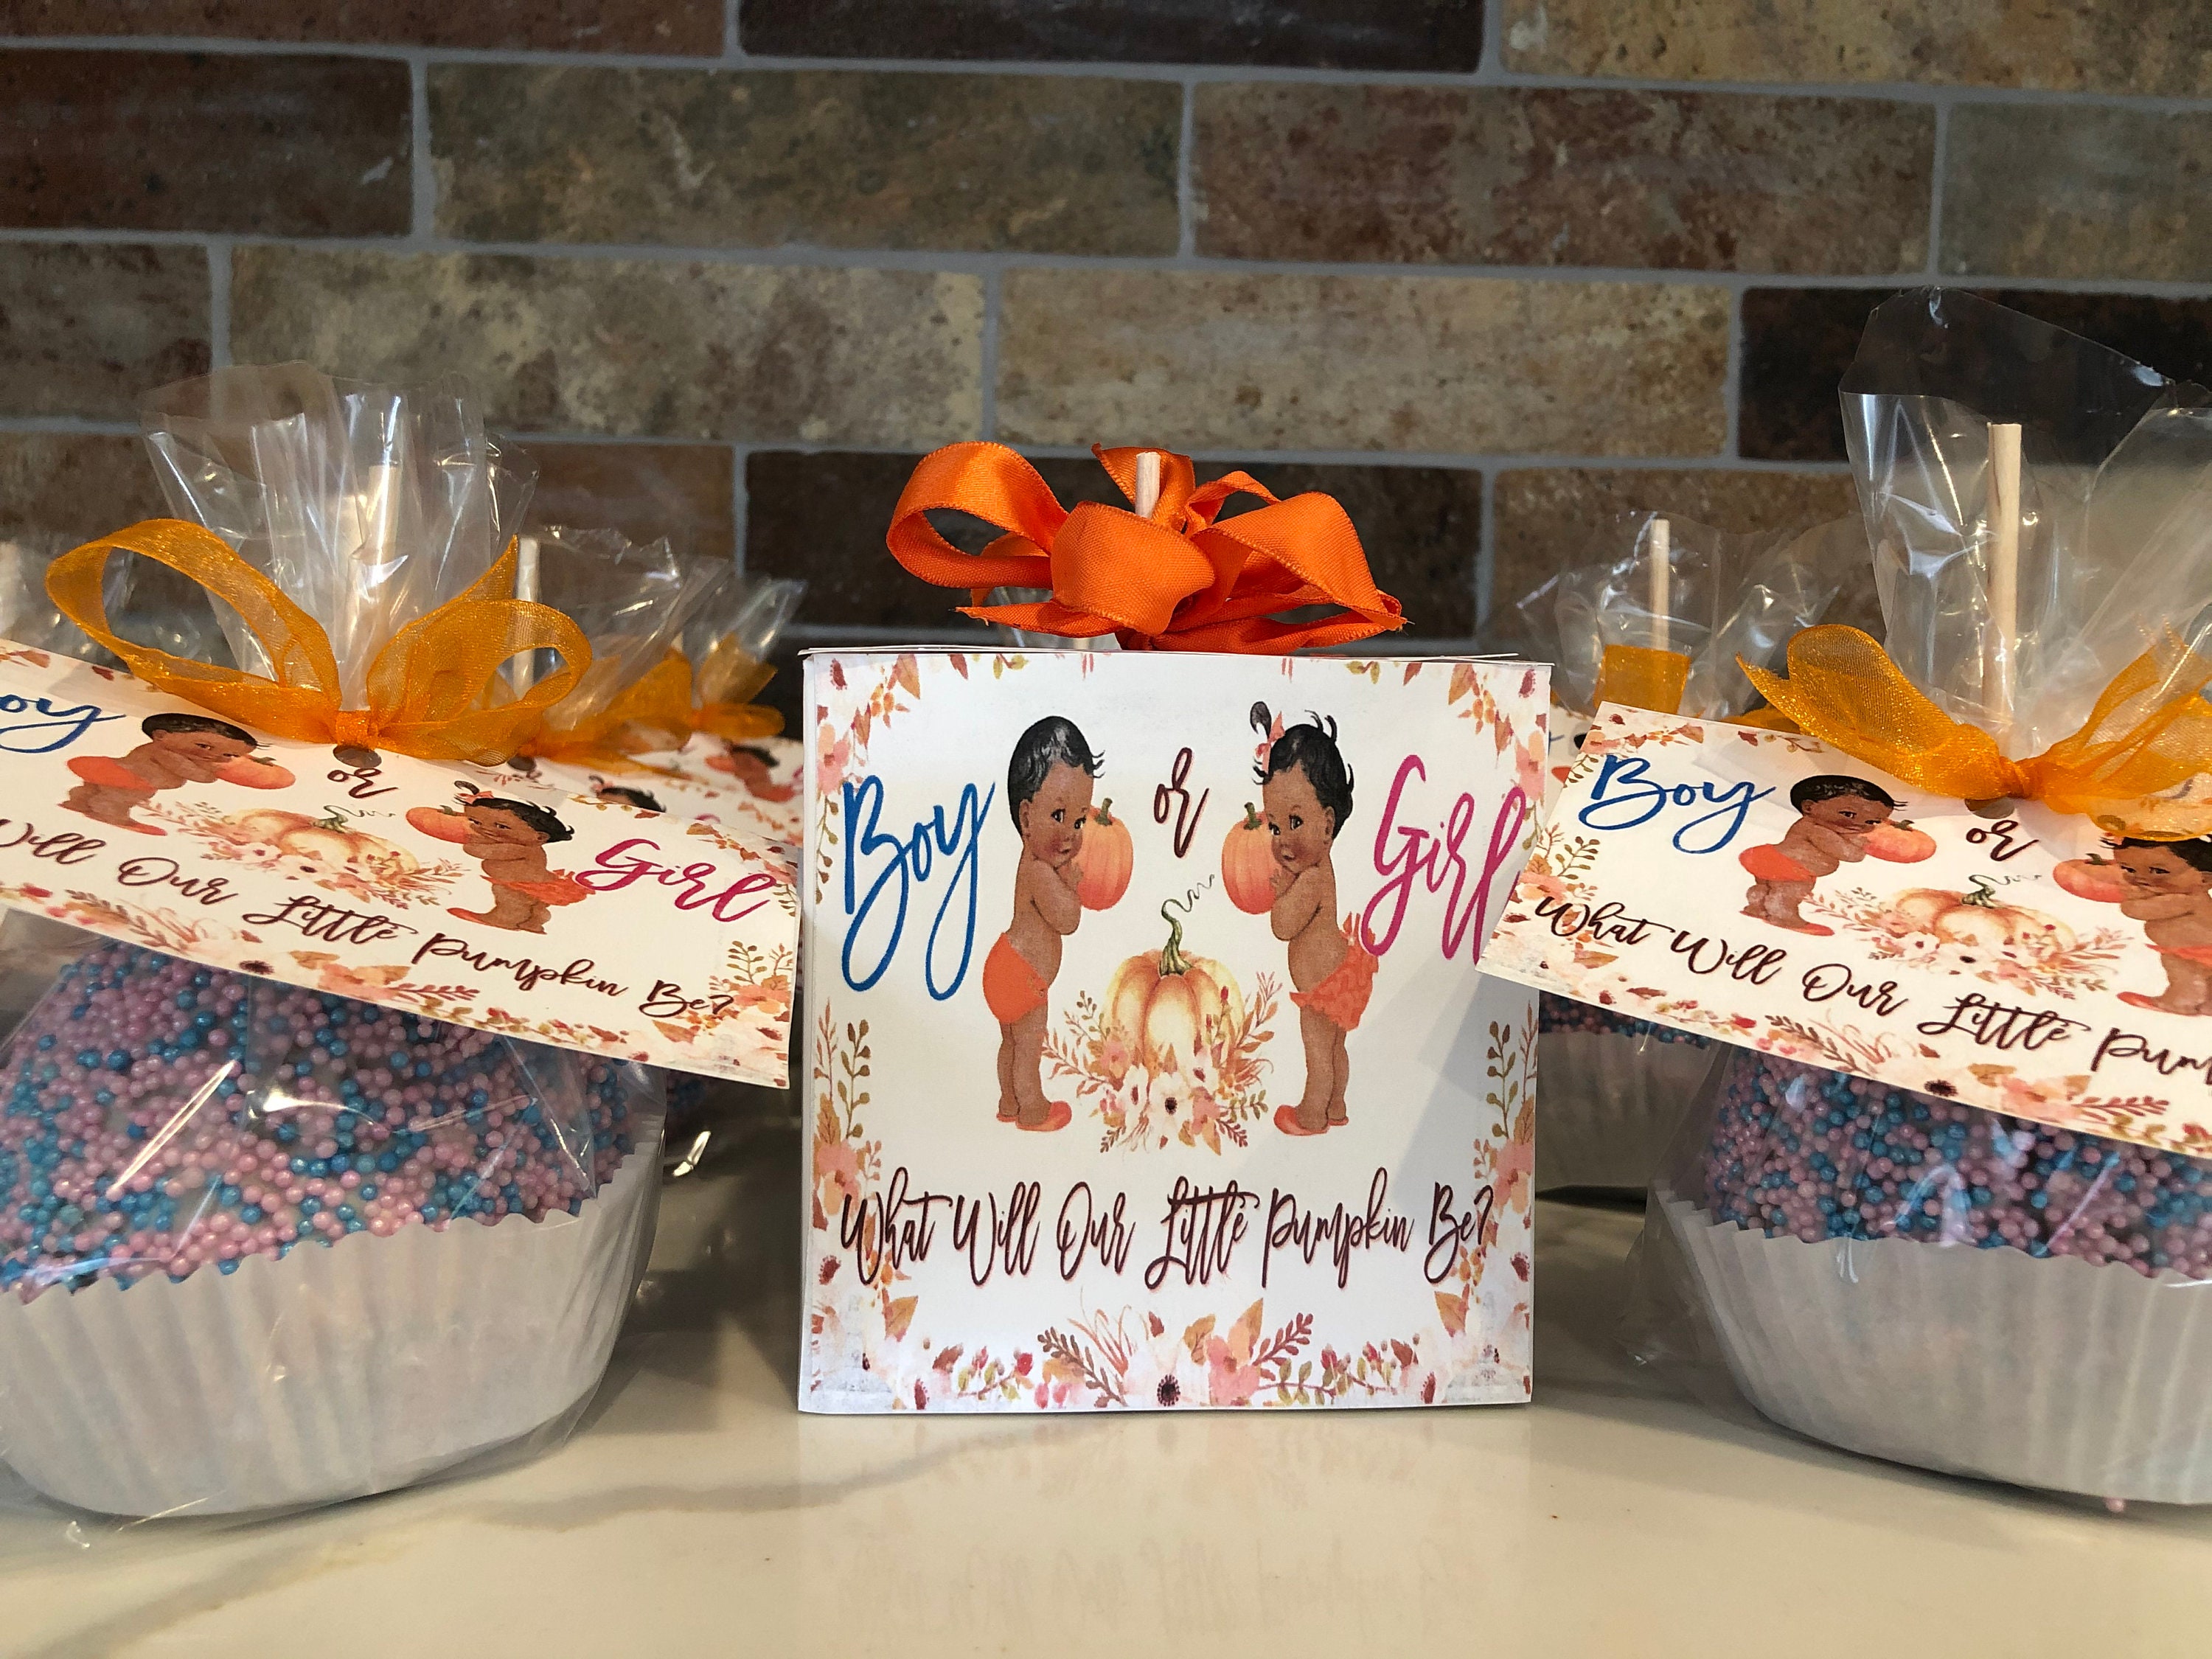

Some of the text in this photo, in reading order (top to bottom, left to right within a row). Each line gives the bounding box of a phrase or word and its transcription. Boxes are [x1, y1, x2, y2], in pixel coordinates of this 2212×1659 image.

[0, 695, 778, 922] oy or Girl
[842, 746, 1526, 1001] Boy or Girl
[1578, 754, 2039, 861] Boy or
[118, 857, 240, 905] Our
[243, 895, 420, 945] Little
[411, 933, 629, 997] Pumpkin
[638, 979, 734, 1018] Be?
[1534, 896, 1675, 946] What
[1669, 931, 1788, 985] Will
[1801, 963, 1909, 1016] Our
[1917, 992, 2092, 1050] Little
[841, 1167, 1495, 1291] What Will Our Little Pumpkin Be?
